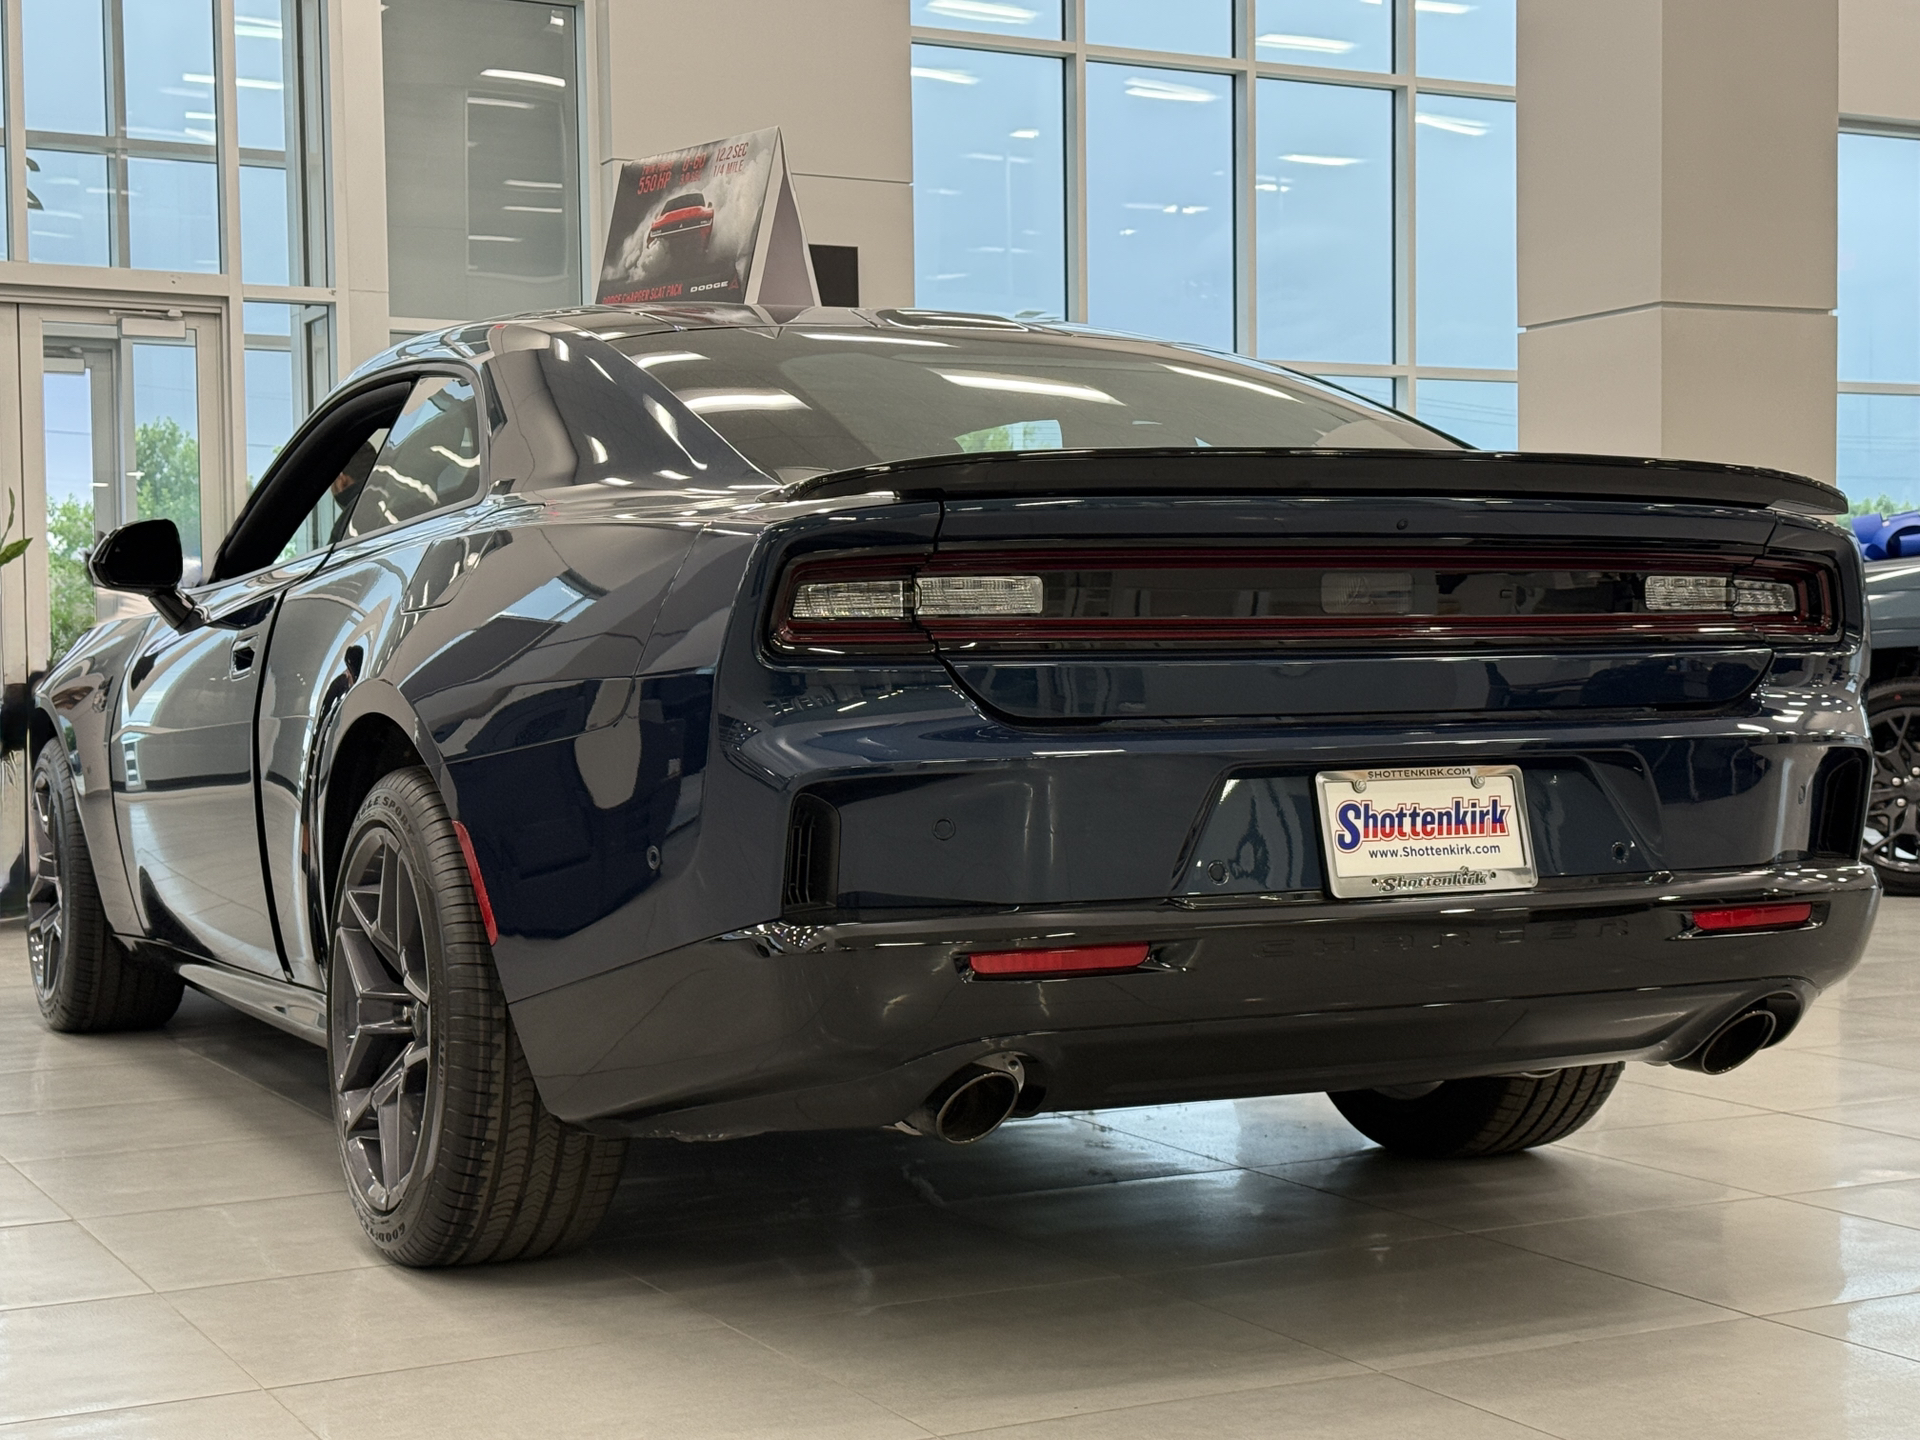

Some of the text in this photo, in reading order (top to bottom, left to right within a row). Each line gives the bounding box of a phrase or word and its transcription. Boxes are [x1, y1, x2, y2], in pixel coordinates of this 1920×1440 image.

[682, 152, 707, 172] 0-60
[716, 142, 749, 162] 12.2 SEC
[714, 160, 744, 177] 1/4 MILE
[637, 171, 672, 195] 550 HP
[650, 285, 666, 300] SCAT
[666, 283, 683, 298] PACK
[690, 280, 729, 293] DODGE
[1367, 767, 1472, 779] SHOTTENKIRK.COM
[381, 796, 415, 836] SPORT
[1337, 797, 1510, 852] Shottenkirk
[1368, 844, 1501, 859] www.Shottenkirk.com
[1380, 868, 1487, 892] Shottenkirk
